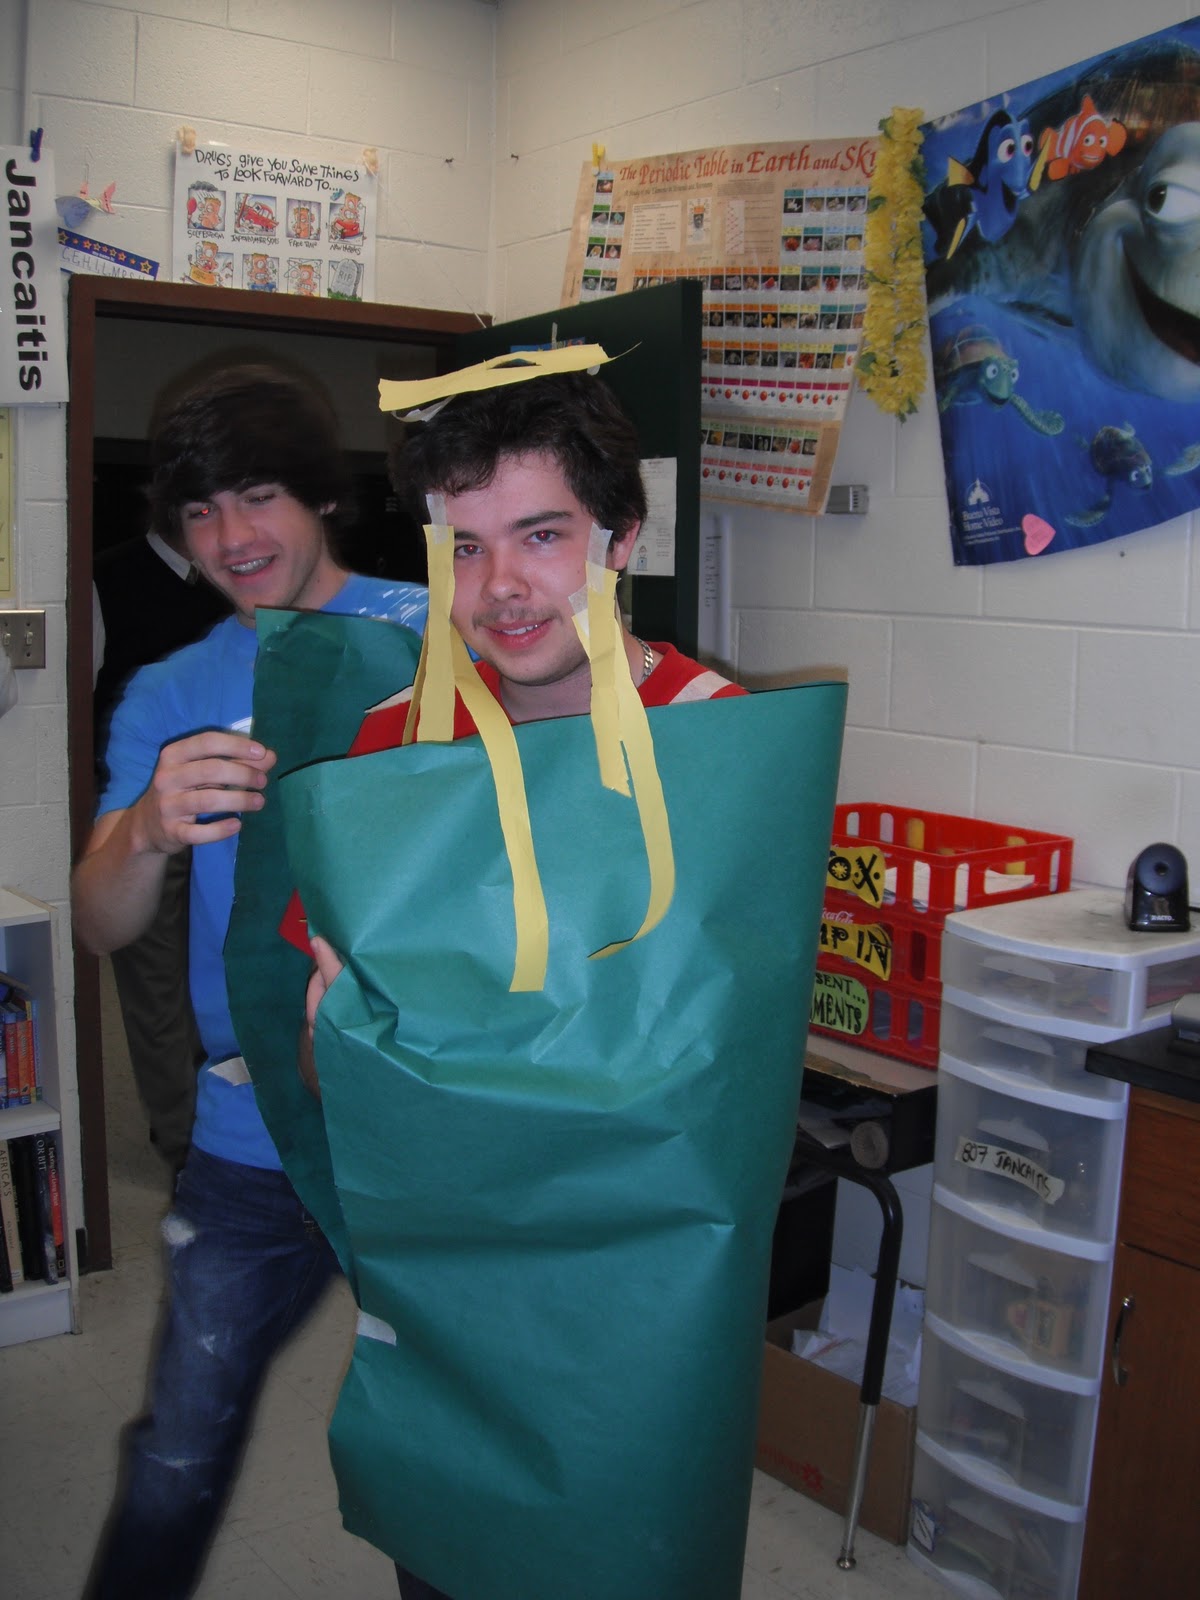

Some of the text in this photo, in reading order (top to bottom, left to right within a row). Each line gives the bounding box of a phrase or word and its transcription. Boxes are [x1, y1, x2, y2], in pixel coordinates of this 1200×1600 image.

[195, 149, 232, 168] DRUGS
[239, 153, 264, 168] give
[620, 163, 637, 182] The
[639, 161, 691, 186] Periodic
[693, 151, 729, 180] Table
[731, 158, 743, 174] in
[746, 145, 810, 174] Earth
[813, 150, 842, 171] and
[263, 170, 313, 188] FORWARD
[5, 159, 48, 391] Jancaitis
[337, 270, 353, 283] RIP
[856, 927, 889, 975] IN
[810, 992, 862, 1034] MENTS
[36, 1139, 47, 1171] ORBIT
[961, 1142, 988, 1164] 807
